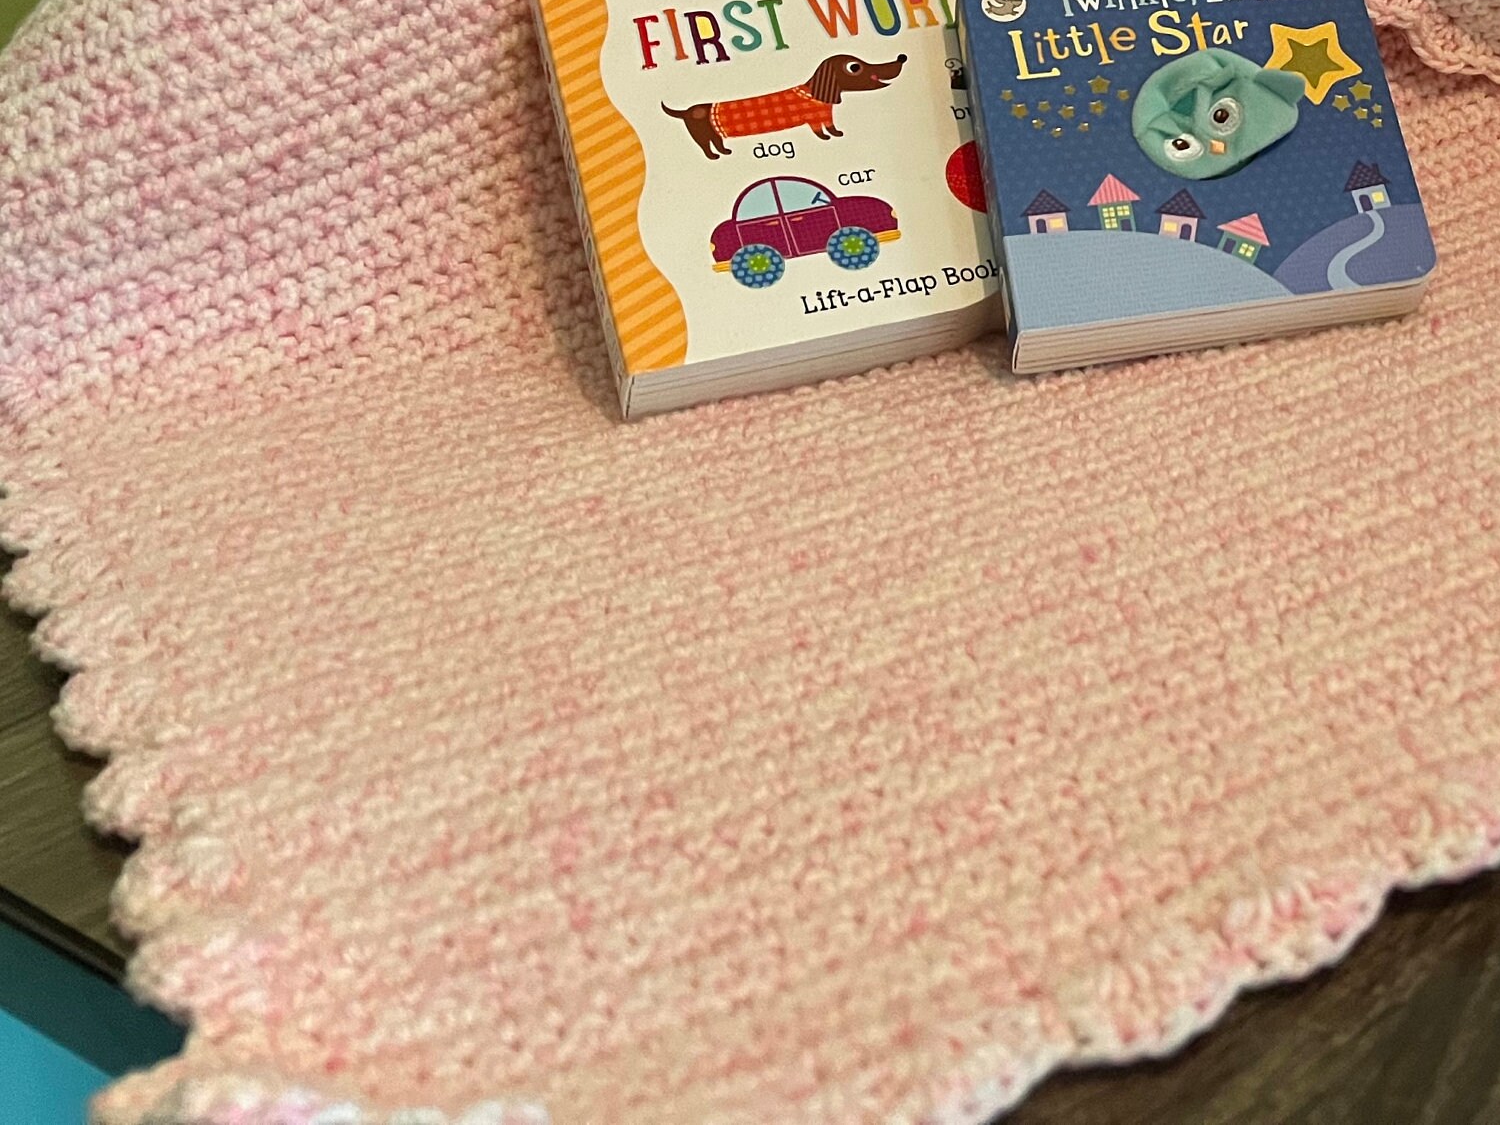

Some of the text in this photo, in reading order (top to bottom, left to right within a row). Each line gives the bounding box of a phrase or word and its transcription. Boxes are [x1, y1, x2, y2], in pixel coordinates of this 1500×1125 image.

[1008, 9, 1249, 80] Little Star
[753, 141, 796, 159] dog
[838, 168, 876, 186] car
[800, 277, 937, 314] Lift-a-Flap
